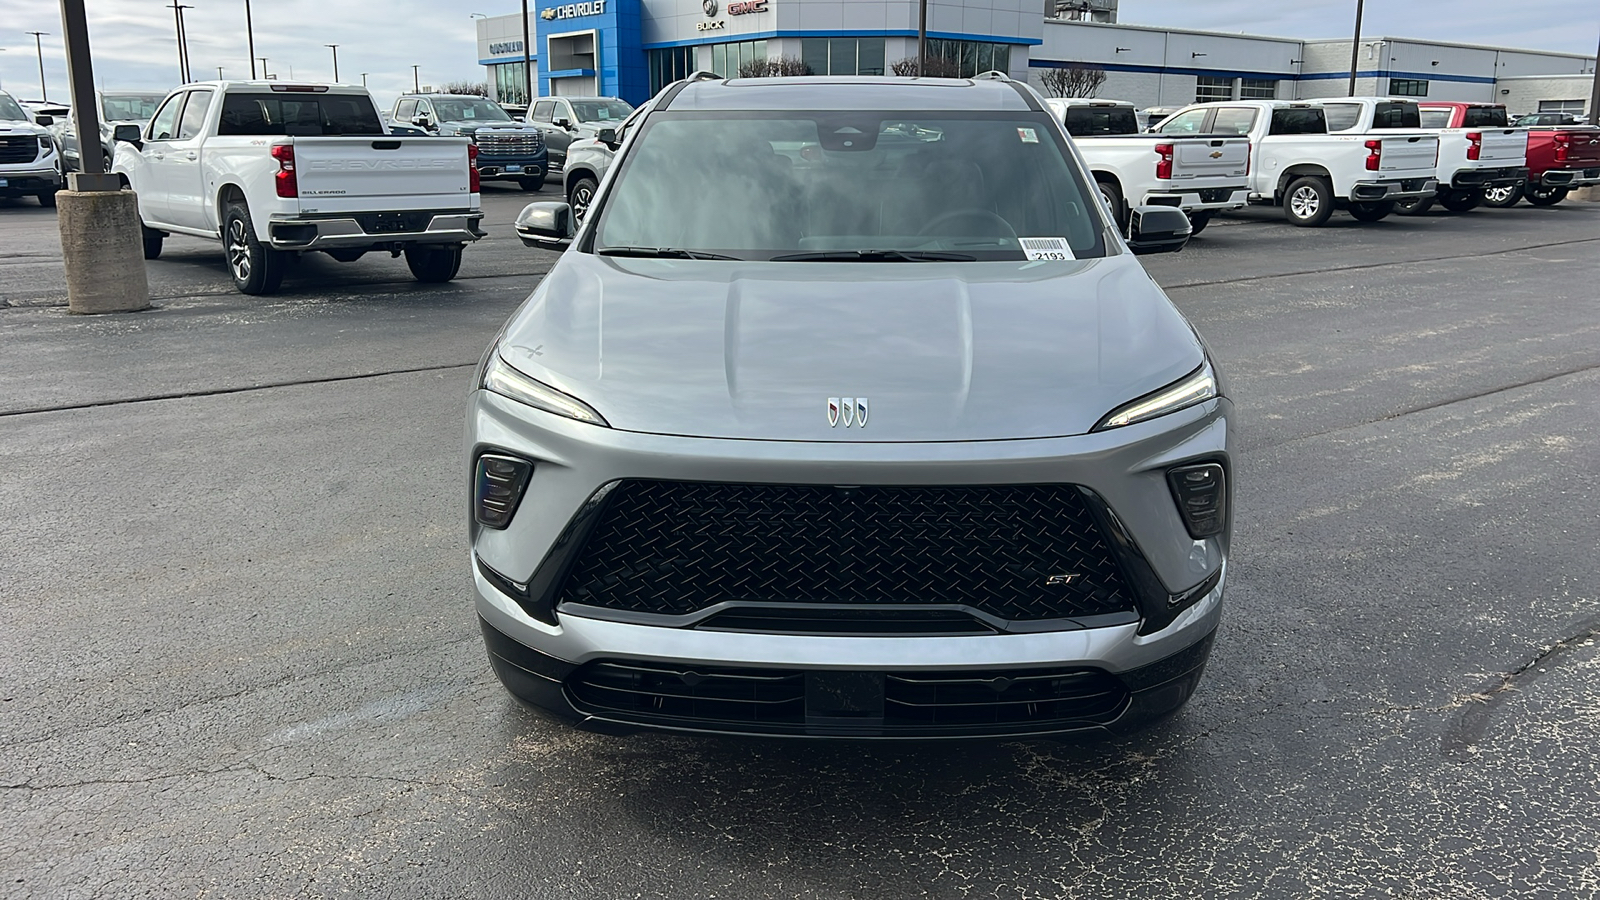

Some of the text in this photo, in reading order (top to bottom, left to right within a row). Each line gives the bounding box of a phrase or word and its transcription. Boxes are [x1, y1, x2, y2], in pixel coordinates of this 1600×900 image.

[557, 0, 605, 19] CHEVROLET
[728, 0, 768, 15] GMC
[696, 20, 724, 31] BUICK
[310, 159, 459, 170] CHEVROLET
[1035, 252, 1065, 260] 2193
[1045, 573, 1080, 585] ST
